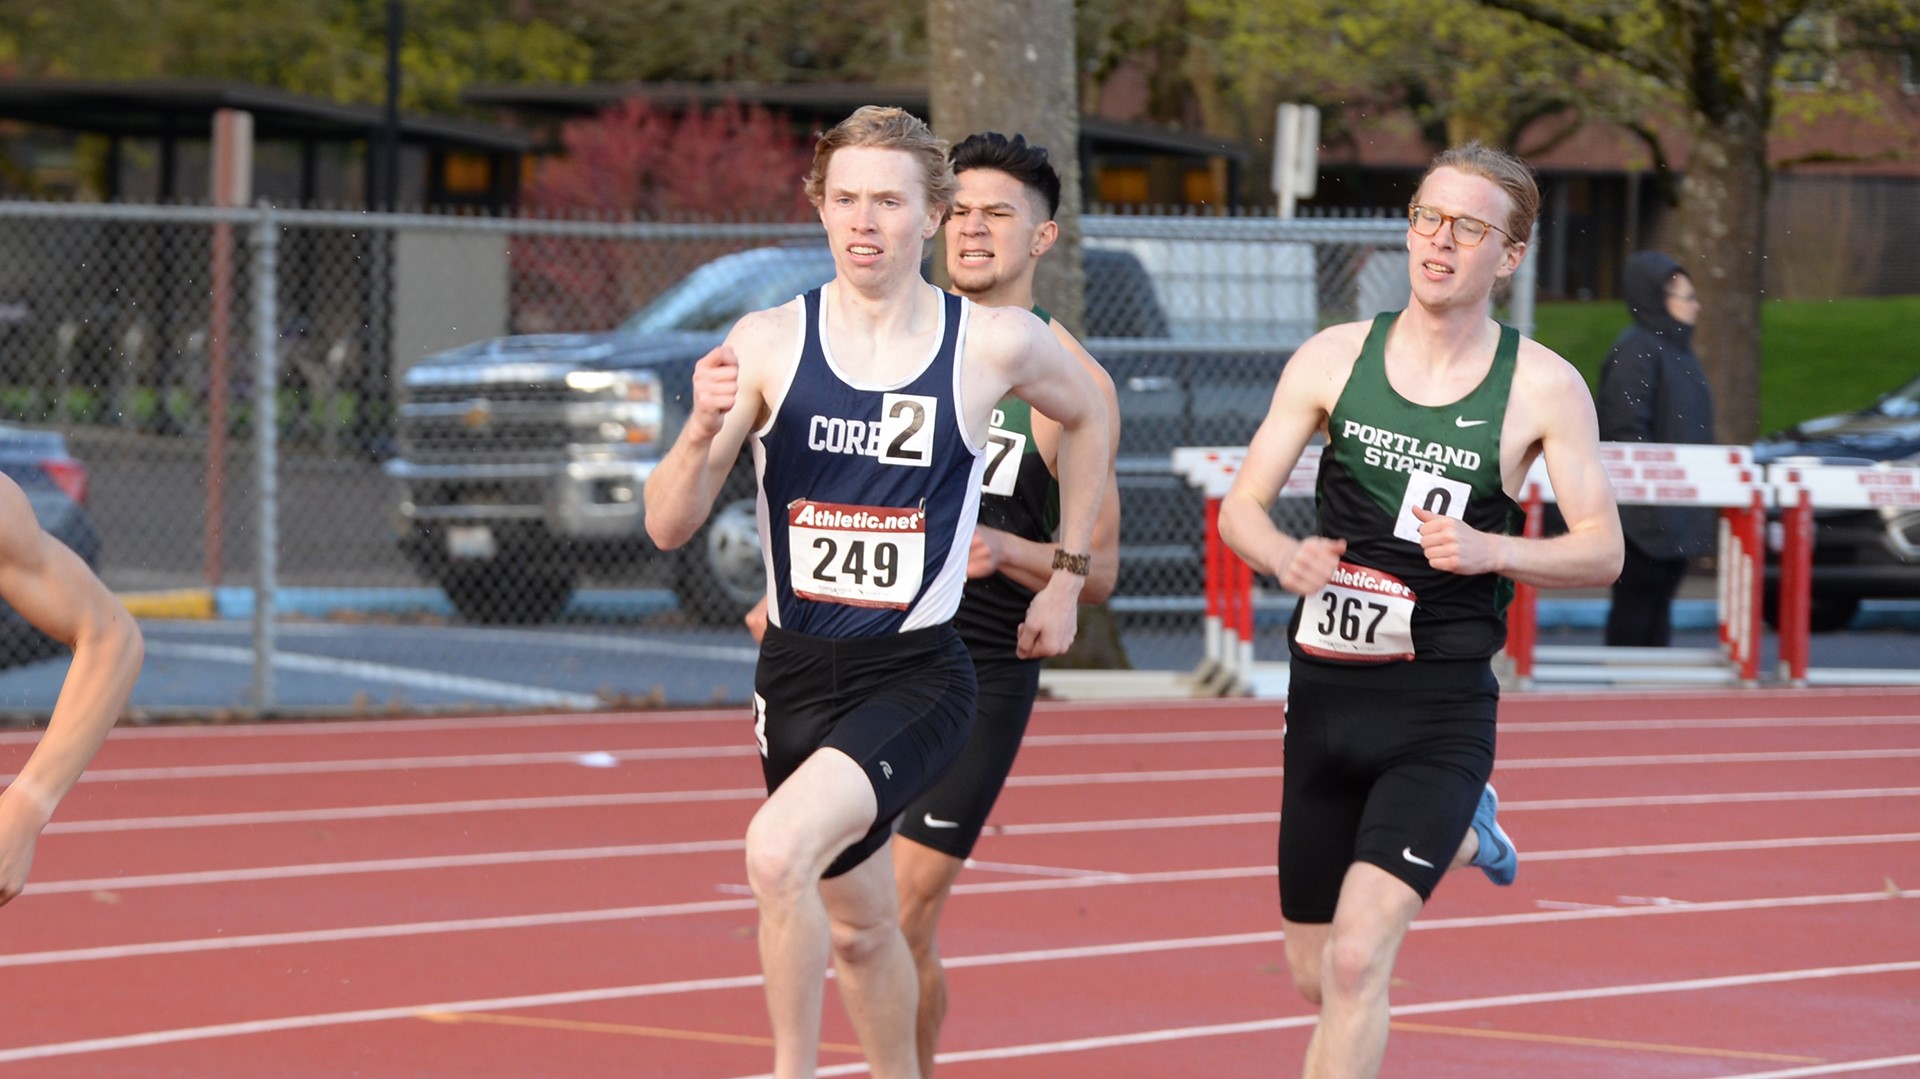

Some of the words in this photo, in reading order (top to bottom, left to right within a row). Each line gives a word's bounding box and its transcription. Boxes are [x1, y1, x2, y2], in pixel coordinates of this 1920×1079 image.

[886, 400, 925, 460] 2
[1342, 419, 1481, 472] PORTLAND
[982, 433, 1016, 487] 7
[1364, 446, 1447, 476] STATE
[794, 505, 918, 530] Athletic.net
[812, 537, 898, 588] 249
[1318, 591, 1388, 644] 367
